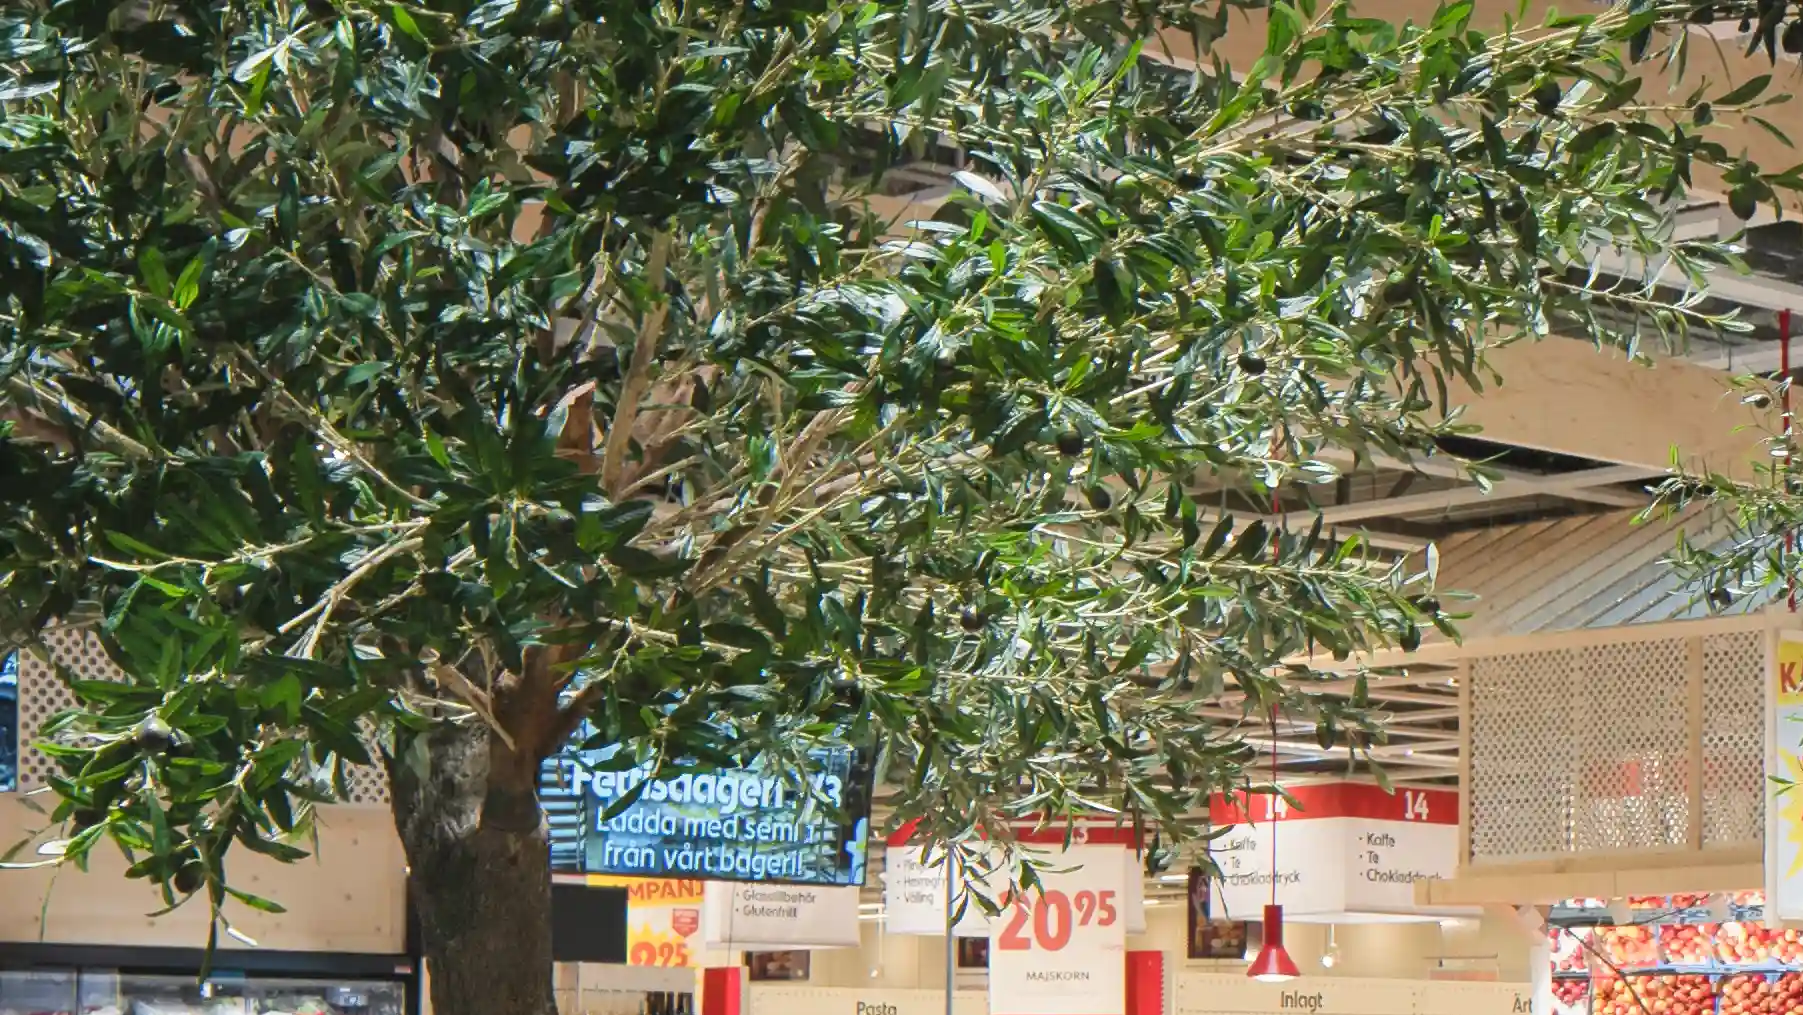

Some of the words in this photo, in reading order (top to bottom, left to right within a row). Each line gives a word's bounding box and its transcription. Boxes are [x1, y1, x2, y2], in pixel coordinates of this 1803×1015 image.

[1264, 793, 1288, 820] 14
[1405, 791, 1429, 820] 14
[597, 805, 676, 835] Ladda
[683, 814, 738, 838] med
[1366, 832, 1396, 848] Kaffe
[603, 843, 655, 868] från
[664, 843, 715, 872] vårt
[720, 847, 803, 879] bageri!
[1230, 856, 1241, 869] Te
[1367, 850, 1379, 864] Te
[628, 879, 705, 900] MPANJ
[1026, 971, 1090, 983] MAJSKORN
[1280, 991, 1324, 1013] Inlagt
[1512, 993, 1533, 1013] Ärt
